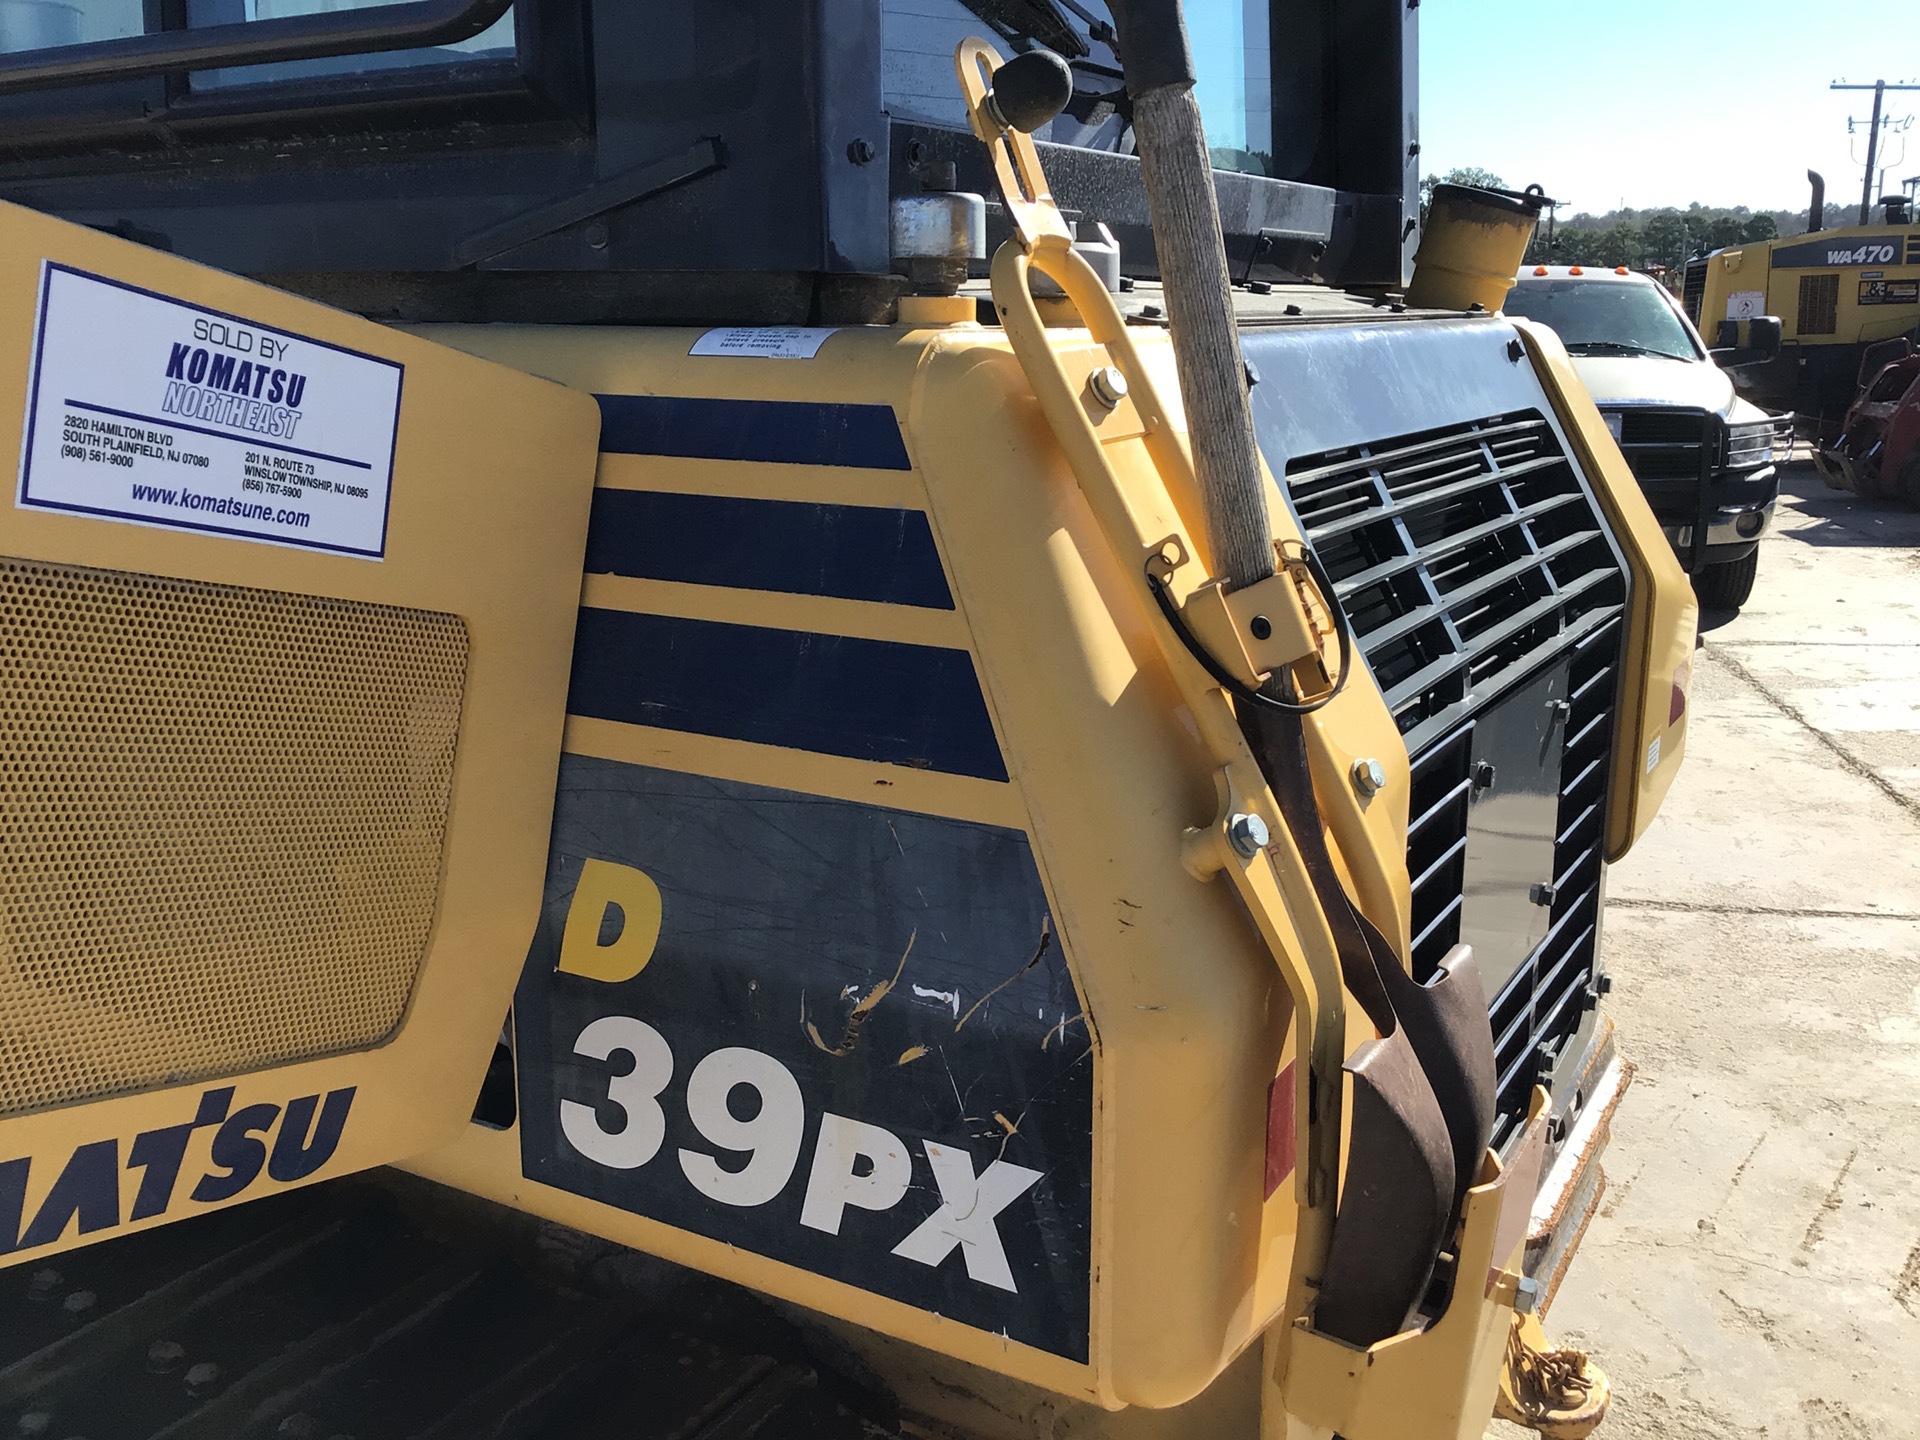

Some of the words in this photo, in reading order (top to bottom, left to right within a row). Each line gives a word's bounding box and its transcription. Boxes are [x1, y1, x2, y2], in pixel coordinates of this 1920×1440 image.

[1827, 245, 1895, 264] WA470
[193, 318, 253, 353] SOLD
[259, 336, 289, 362] BY
[165, 342, 307, 408] KOMATSU
[64, 414, 89, 430] 2820
[91, 419, 145, 442] HAMILTON
[147, 431, 173, 447] BLVD
[162, 381, 302, 440] NORTHEAST
[60, 444, 87, 462] (908)
[88, 449, 134, 468] 561-9000
[62, 429, 100, 447] SOUTH
[102, 437, 165, 461] PLAINFIELD,
[167, 451, 181, 463] NJ
[182, 454, 209, 468] 07080
[245, 451, 260, 464] 201
[262, 454, 271, 466] N.
[273, 457, 303, 473] ROUTE
[305, 463, 315, 475] 73
[242, 477, 264, 494] (856)
[265, 482, 302, 499] 767-5900
[244, 464, 287, 483] WINSLOW
[288, 473, 333, 493] TOWNSHIP,
[334, 482, 345, 495] NJ
[346, 485, 369, 499] 08095
[132, 483, 310, 528] www.komatsune.com
[558, 858, 663, 984] D
[0, 1085, 358, 1256] ATSU
[560, 1015, 1046, 1295] 39PX
